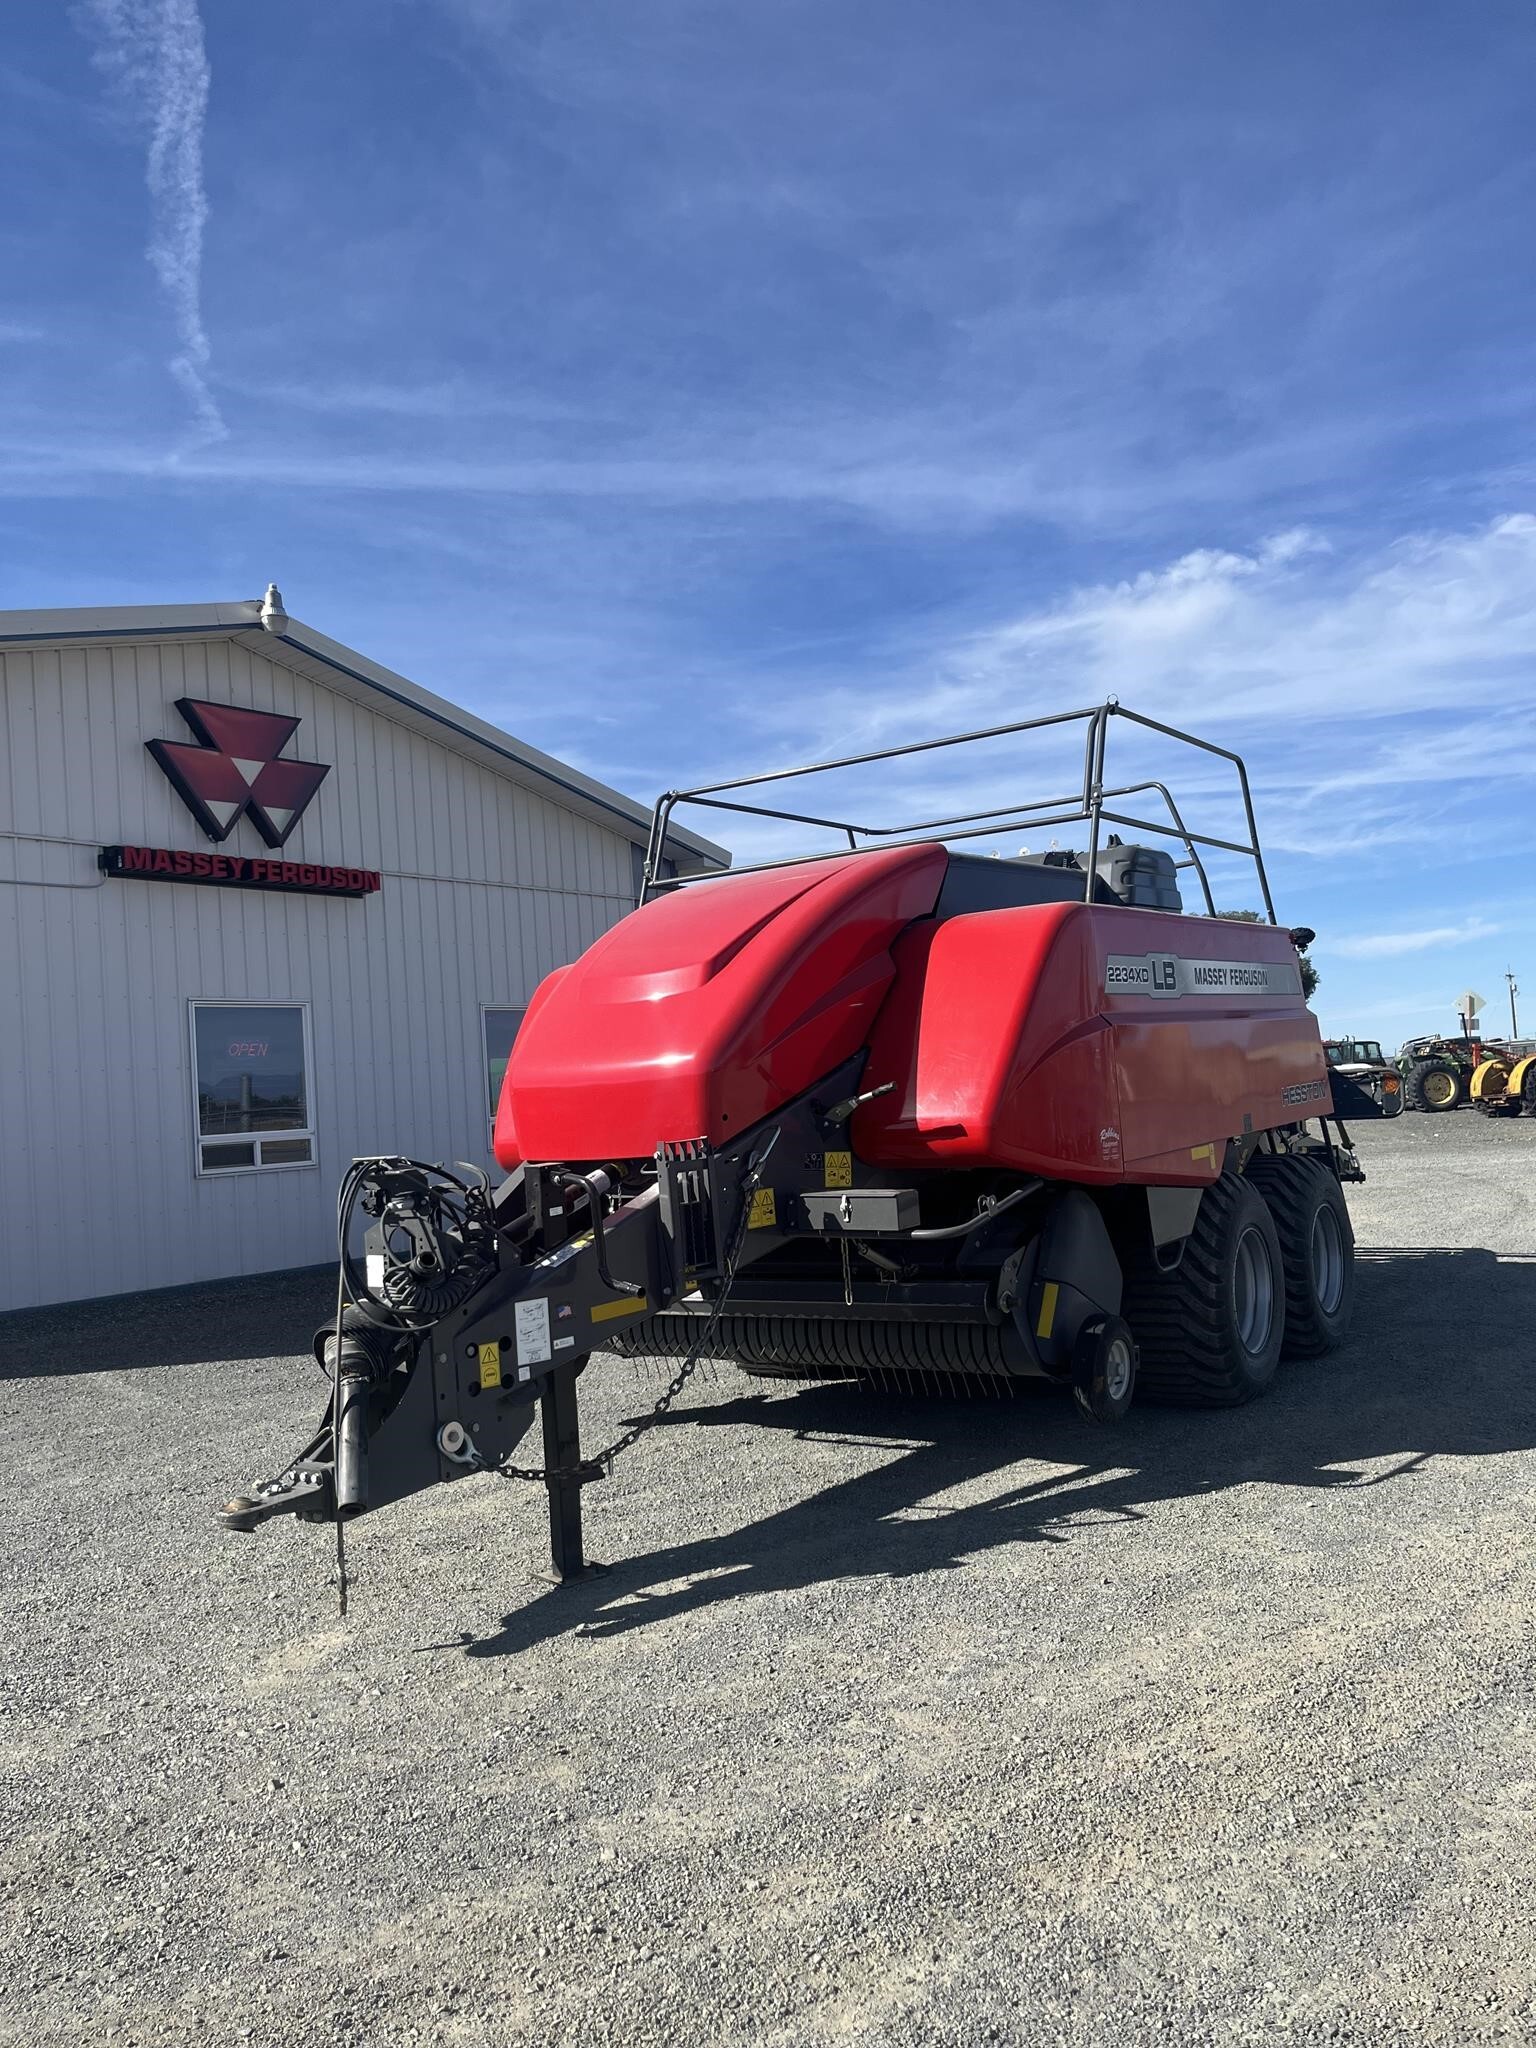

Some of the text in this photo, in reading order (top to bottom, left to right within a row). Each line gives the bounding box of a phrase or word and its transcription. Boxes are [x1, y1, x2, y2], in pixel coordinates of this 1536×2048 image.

[124, 847, 381, 891] MASSEY FERGUSON
[1107, 960, 1268, 991] 2234XD LB MASSEY FERGUSON
[229, 1043, 269, 1056] OPEN
[1281, 1081, 1326, 1105] HESSTON
